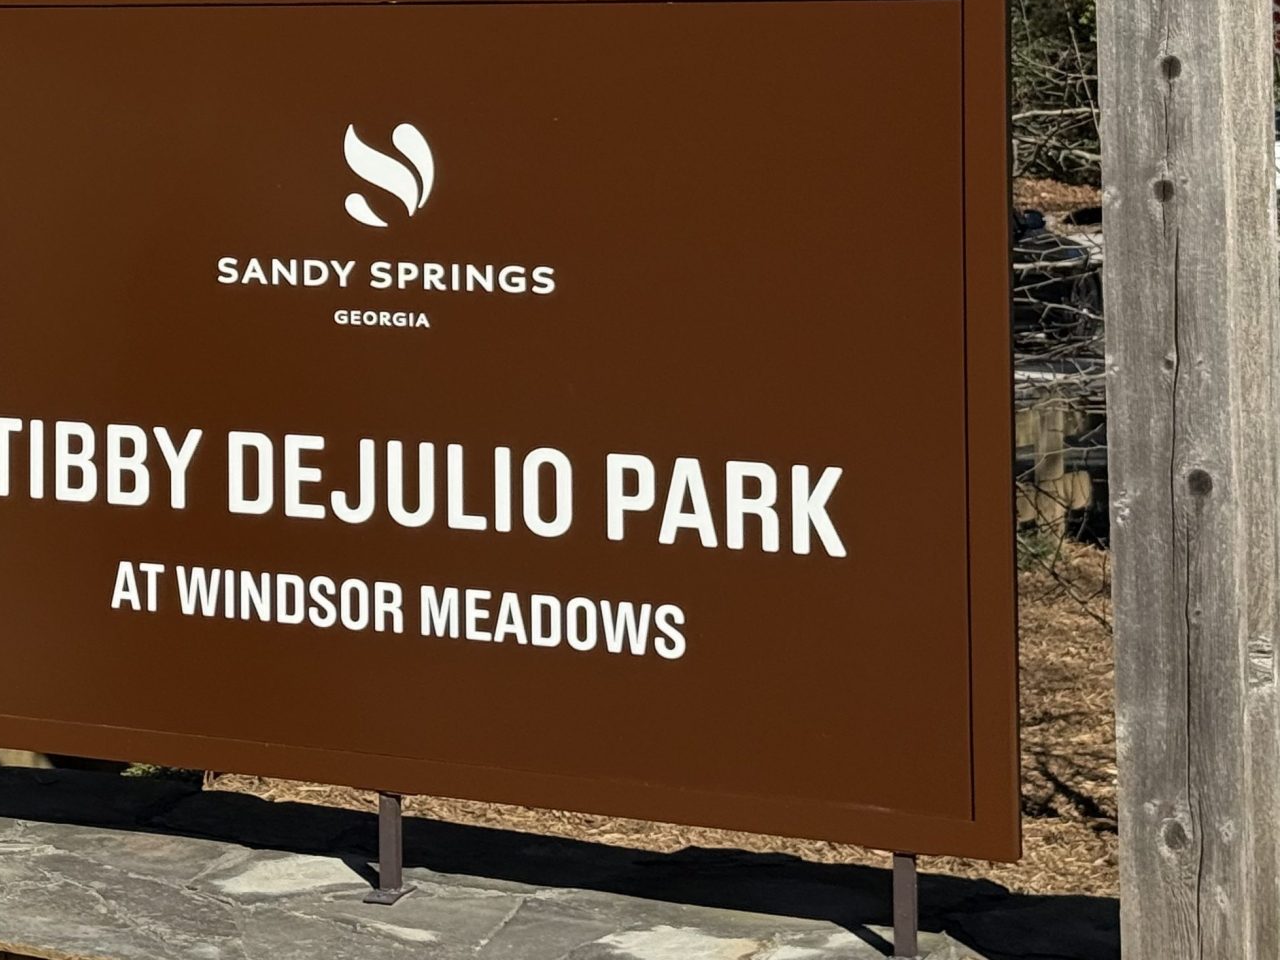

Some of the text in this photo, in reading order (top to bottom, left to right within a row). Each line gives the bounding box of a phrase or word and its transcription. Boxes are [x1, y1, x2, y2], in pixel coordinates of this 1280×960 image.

[217, 257, 556, 295] SANDY SPRINGS
[334, 309, 431, 328] GEORGIA
[228, 430, 573, 538] DEJULIO
[606, 453, 847, 558] PARK
[111, 560, 687, 660] AT WINDSOR MEADOWS
